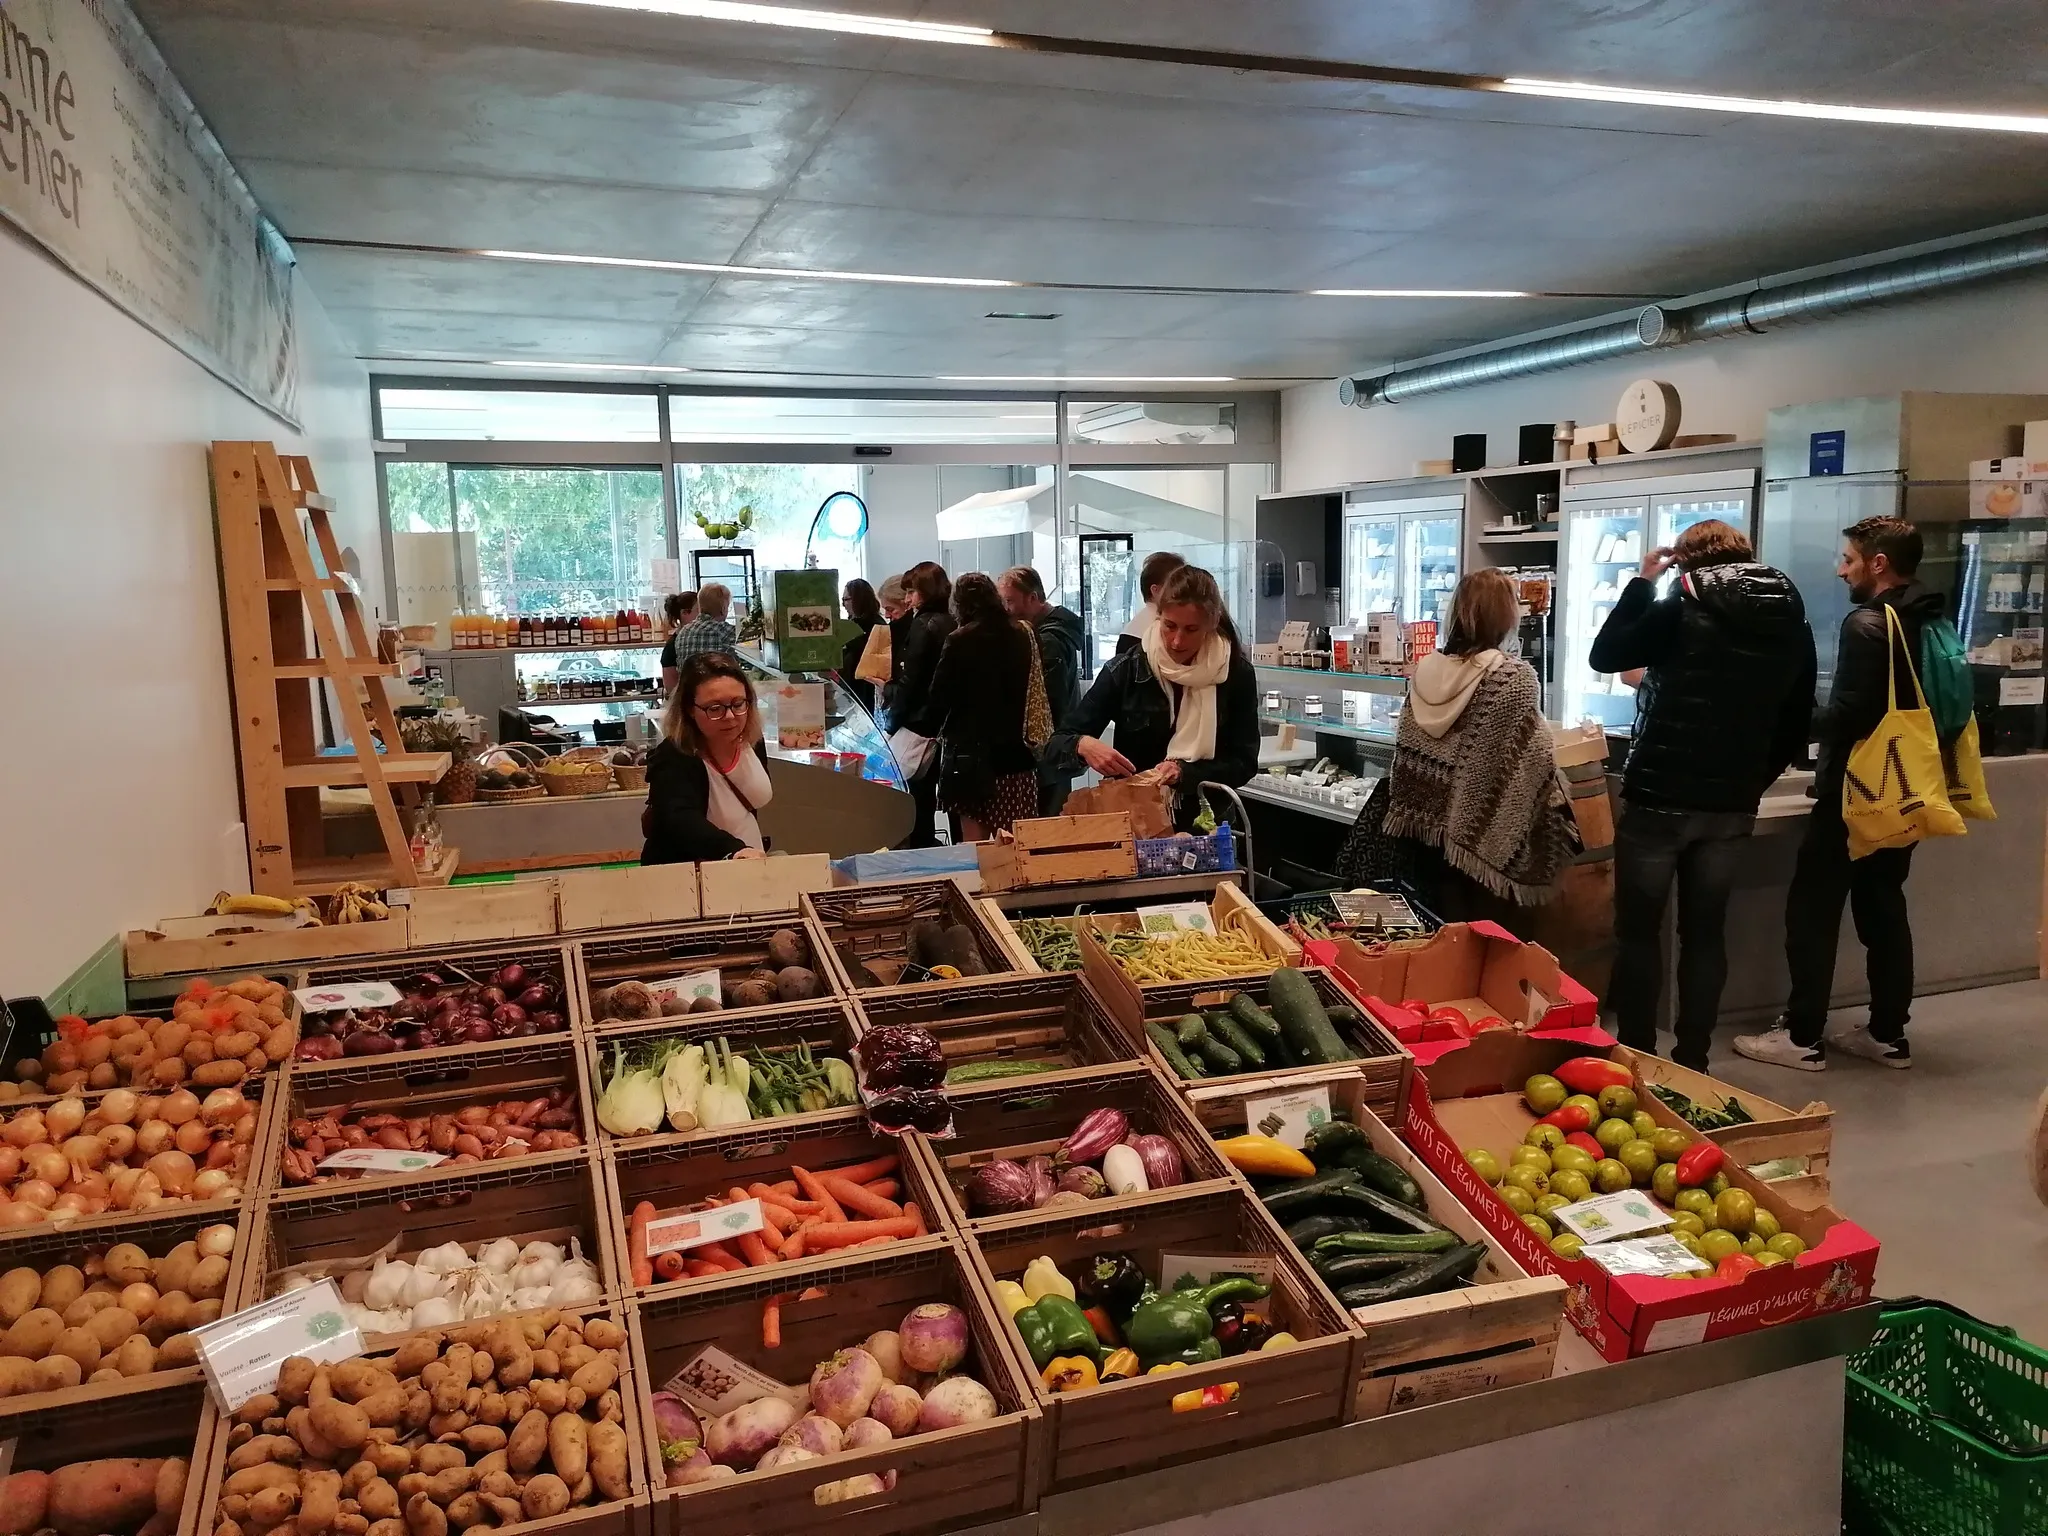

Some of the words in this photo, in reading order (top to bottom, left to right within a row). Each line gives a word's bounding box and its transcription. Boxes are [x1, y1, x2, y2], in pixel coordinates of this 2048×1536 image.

[1406, 1103, 1434, 1148] RUITS
[1436, 1141, 1452, 1164] ET
[1451, 1159, 1498, 1223] LÉGUMES
[1709, 1299, 1760, 1324] LÉGUMES
[1763, 1287, 1811, 1311] D'ALSACE
